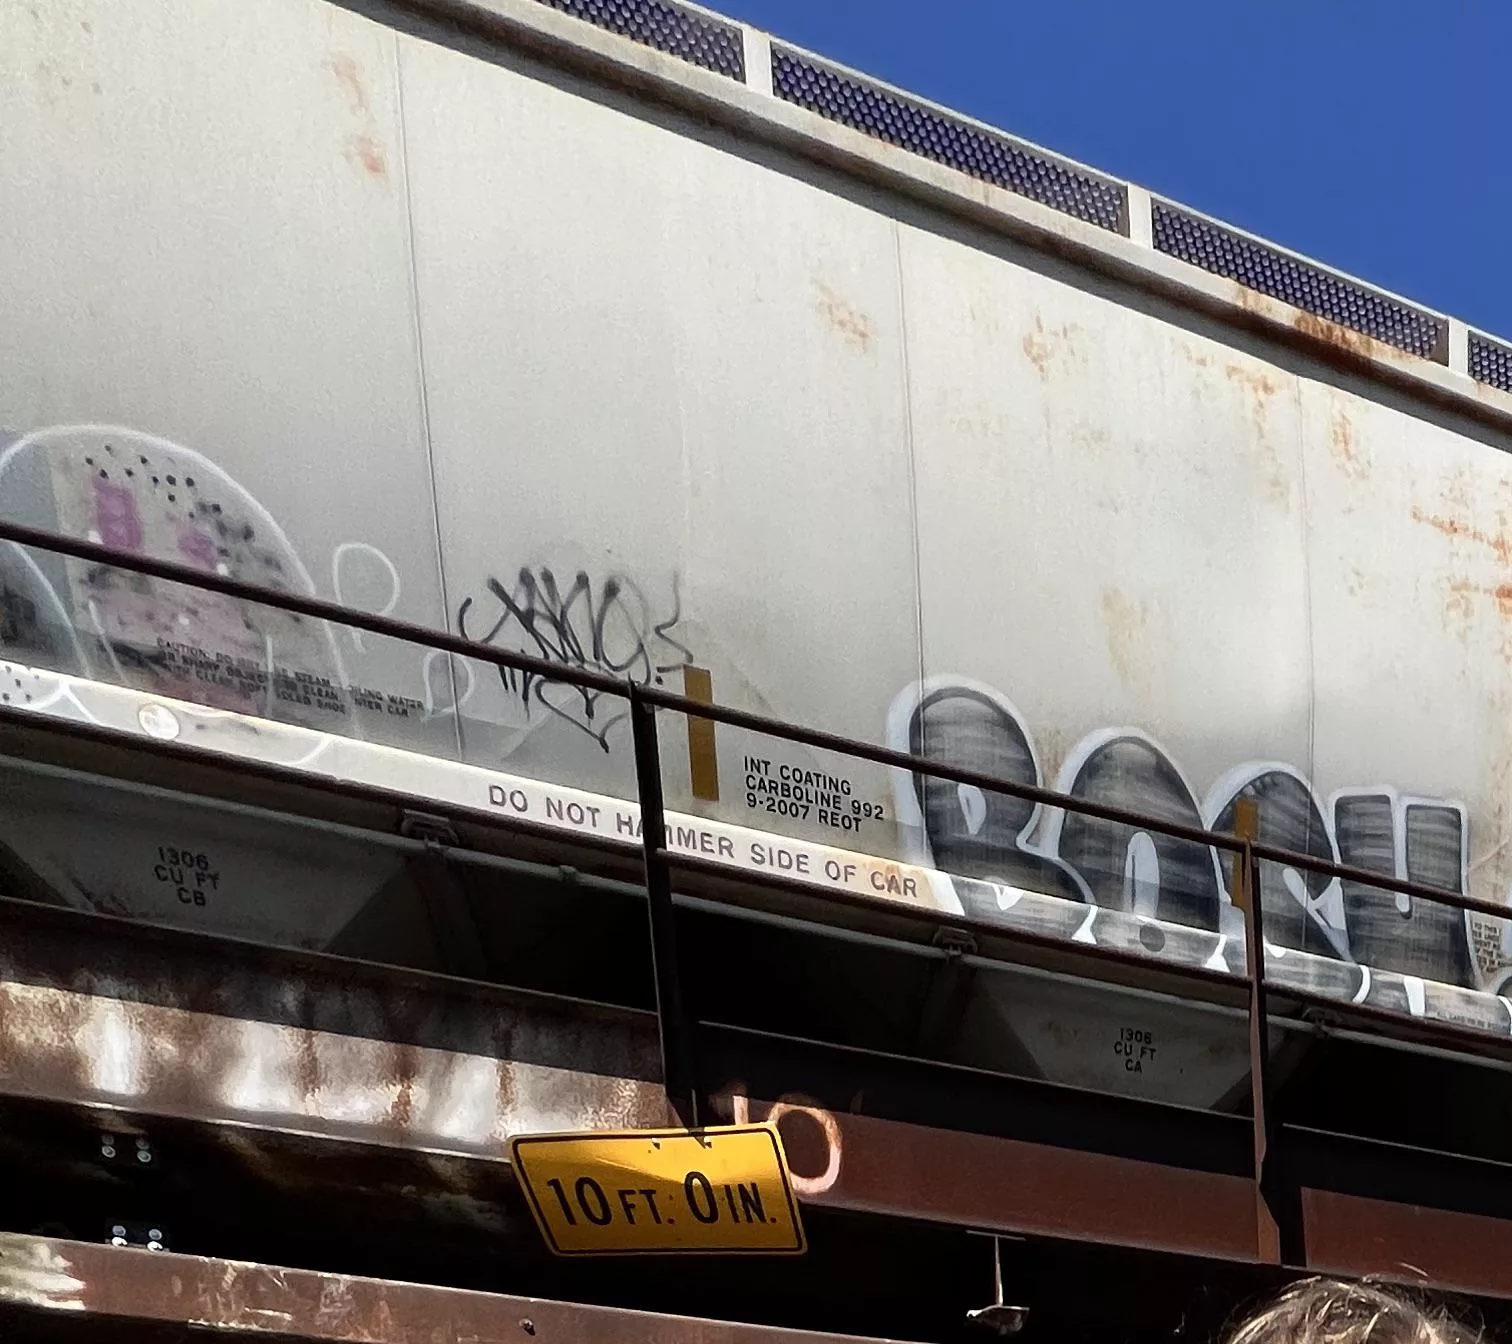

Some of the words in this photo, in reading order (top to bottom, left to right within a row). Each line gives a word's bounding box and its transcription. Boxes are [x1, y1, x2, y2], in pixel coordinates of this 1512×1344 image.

[387, 694, 425, 712] WATER
[744, 755, 771, 776] INT
[779, 764, 852, 796] COATING
[745, 774, 842, 811] CARBOLINE
[851, 799, 885, 821] 992
[818, 808, 863, 833] REOT
[488, 784, 529, 813] DO
[545, 796, 601, 828] NOT
[750, 843, 810, 875] SIDE
[824, 860, 857, 883] OF
[870, 870, 917, 898] CAR
[158, 846, 209, 871] 1306
[154, 864, 184, 885] CU
[195, 872, 220, 890] FT
[177, 887, 206, 907] CB
[1113, 1040, 1133, 1057] CU
[1139, 1046, 1157, 1061] FT
[1125, 1058, 1143, 1073] CA
[547, 1176, 613, 1226] 10
[617, 1189, 676, 1225] FT.
[683, 1170, 719, 1225] 0
[723, 1182, 778, 1224] IN.
